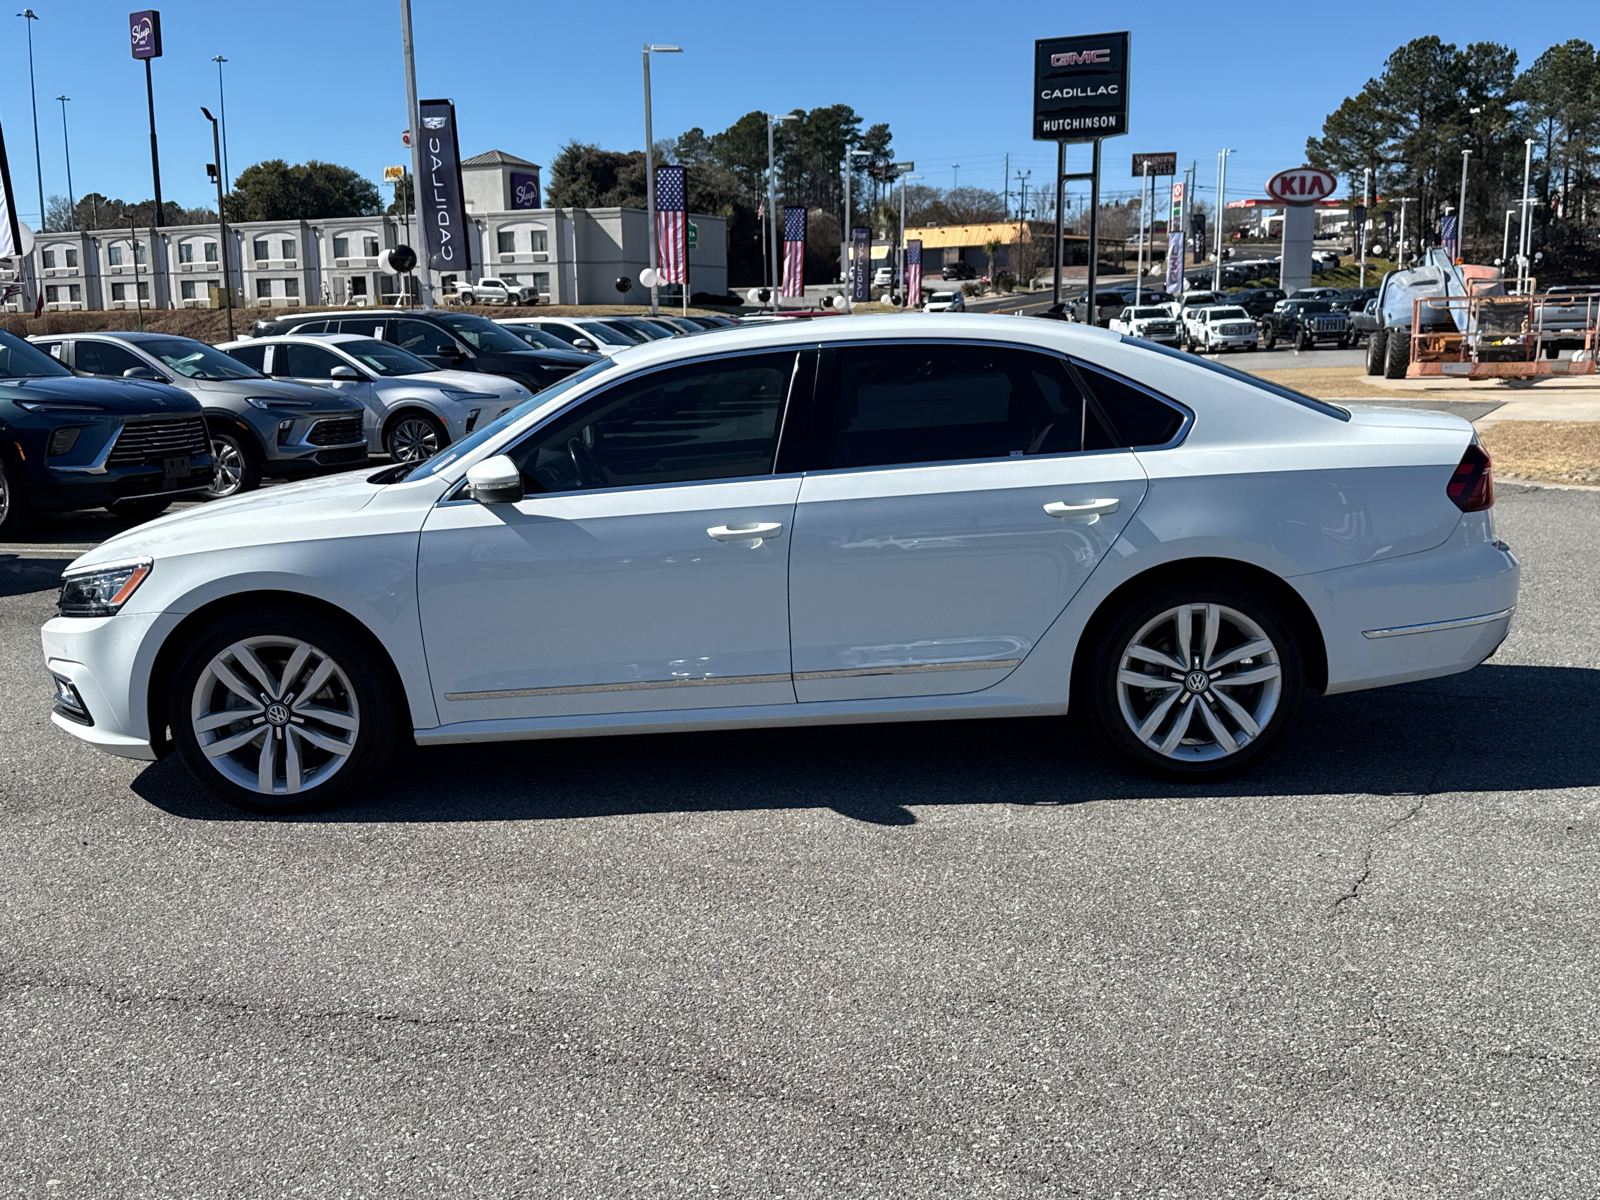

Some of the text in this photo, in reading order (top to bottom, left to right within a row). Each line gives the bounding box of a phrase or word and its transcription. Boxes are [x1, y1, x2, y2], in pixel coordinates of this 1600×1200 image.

[132, 24, 150, 44] Sleep
[1051, 49, 1110, 67] GMC
[1041, 84, 1118, 99] CADILLAC
[1043, 115, 1116, 132] HUTCHINSON
[516, 185, 535, 204] Sleep
[1280, 176, 1325, 195] KIA
